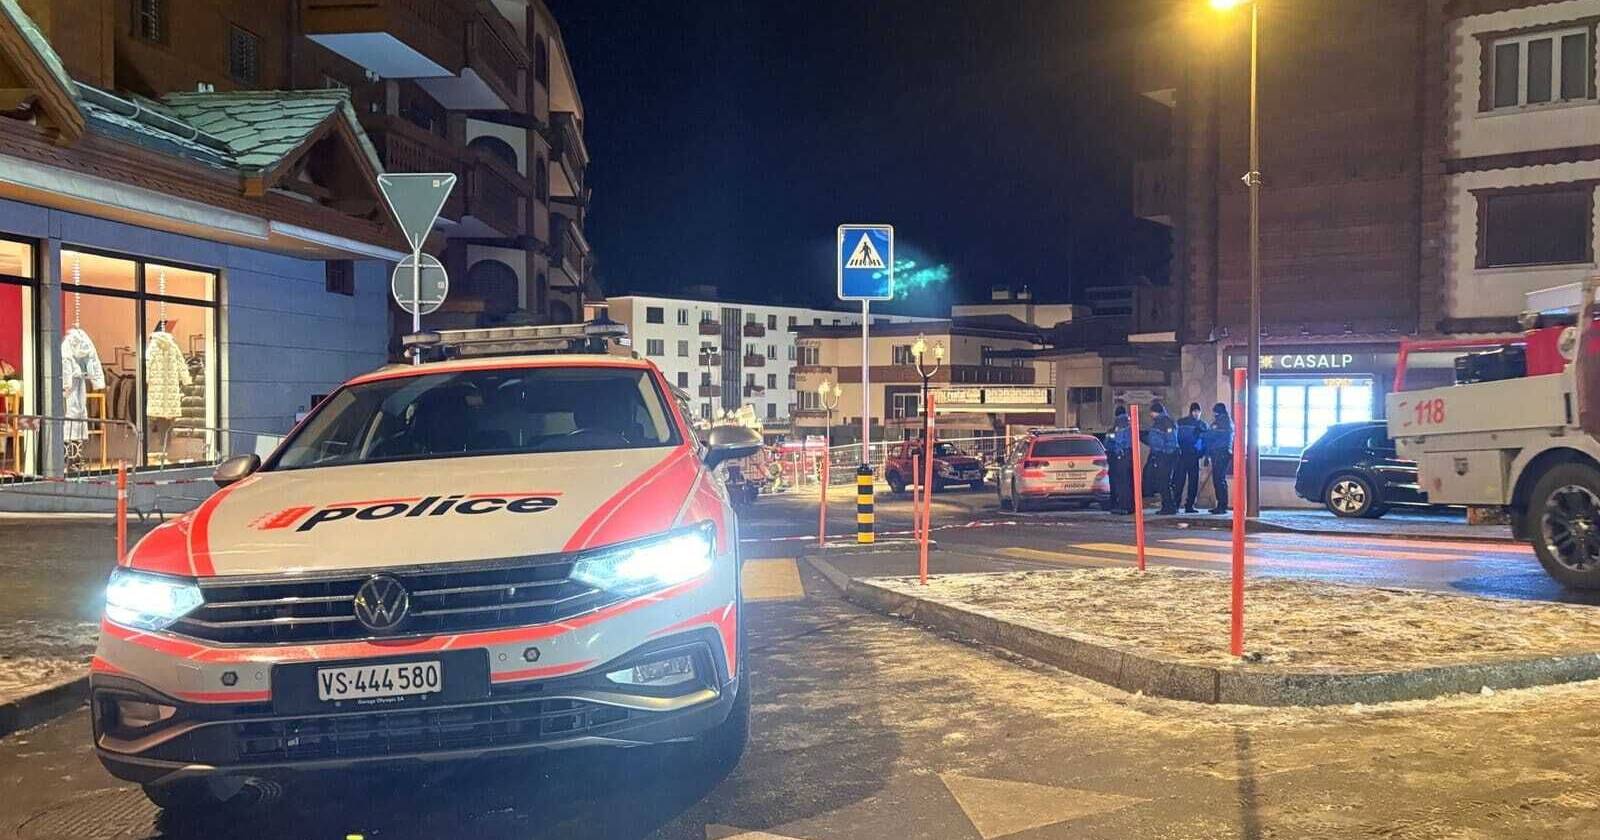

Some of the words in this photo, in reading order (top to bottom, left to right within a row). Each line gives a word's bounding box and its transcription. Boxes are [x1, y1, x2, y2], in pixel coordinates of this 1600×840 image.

[1280, 353, 1353, 369] CASALP
[1414, 398, 1445, 426] 118
[295, 495, 558, 532] police
